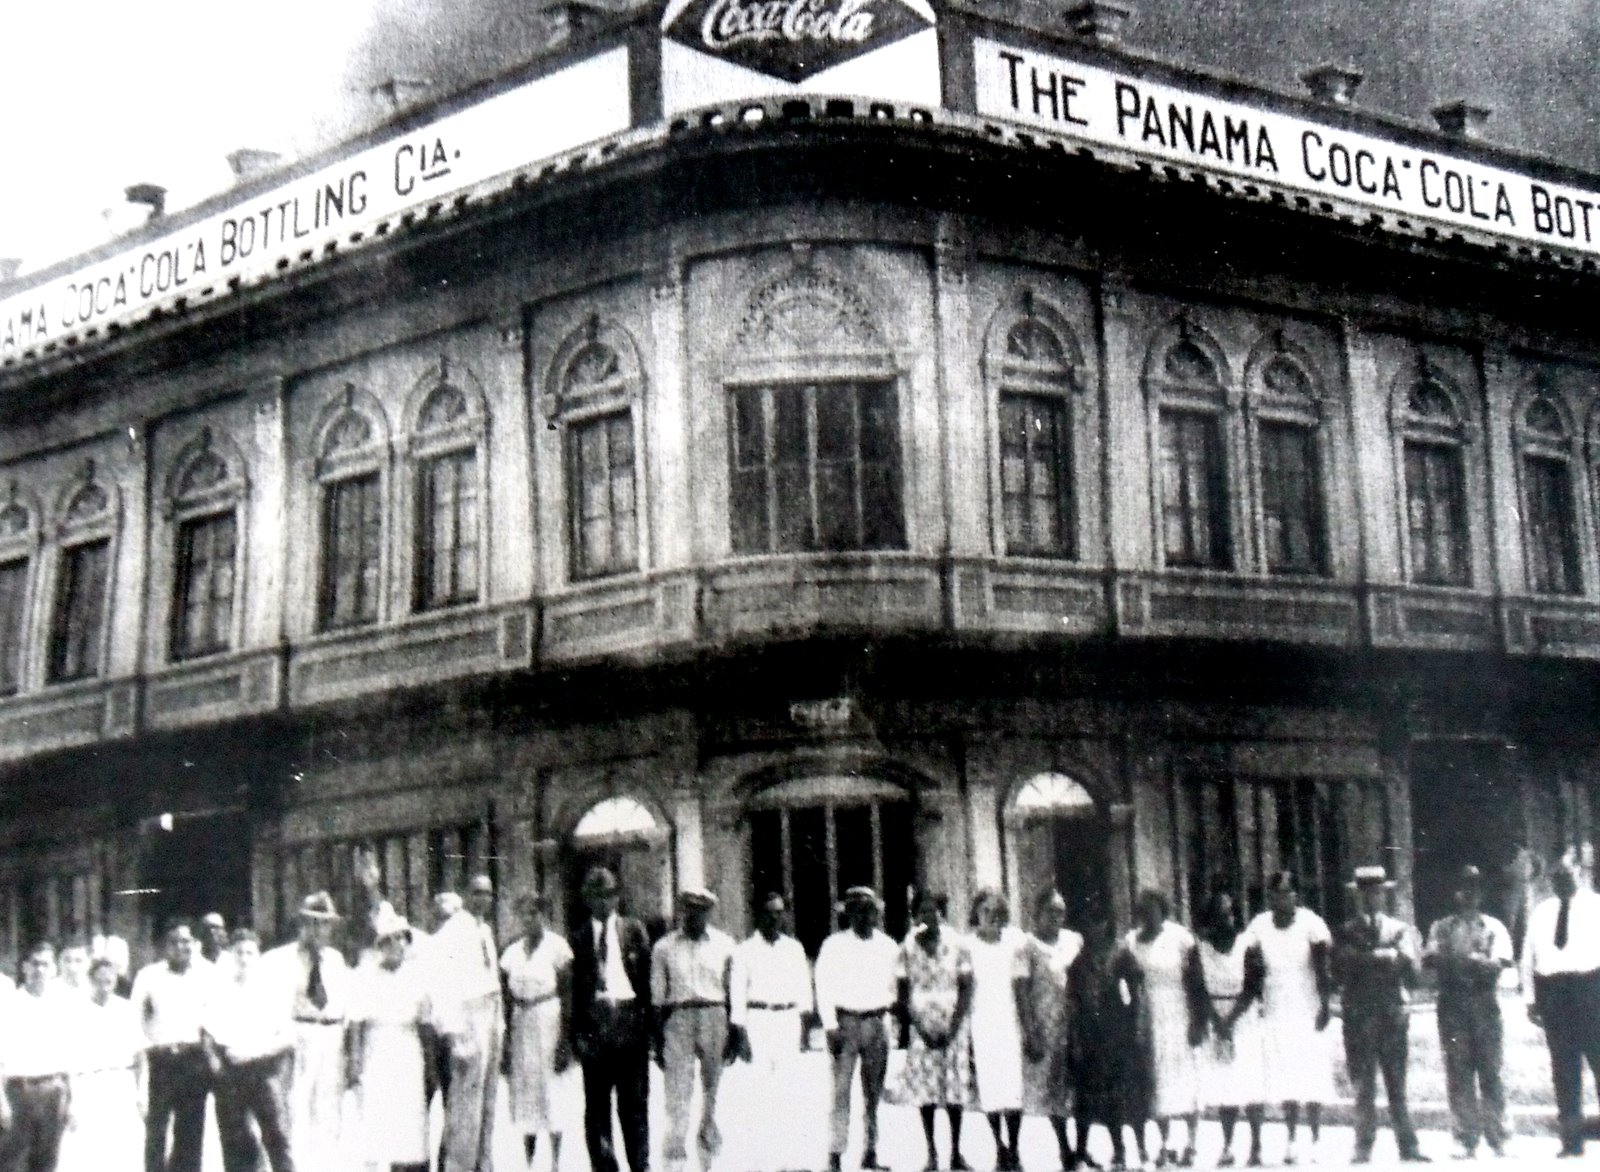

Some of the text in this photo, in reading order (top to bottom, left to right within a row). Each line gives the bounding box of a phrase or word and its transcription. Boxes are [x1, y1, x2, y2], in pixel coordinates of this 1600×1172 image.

[220, 170, 367, 267] BOTTLING
[1000, 50, 1089, 127] THE
[1114, 80, 1279, 173] PANAMA
[1530, 184, 1600, 243] BOT
